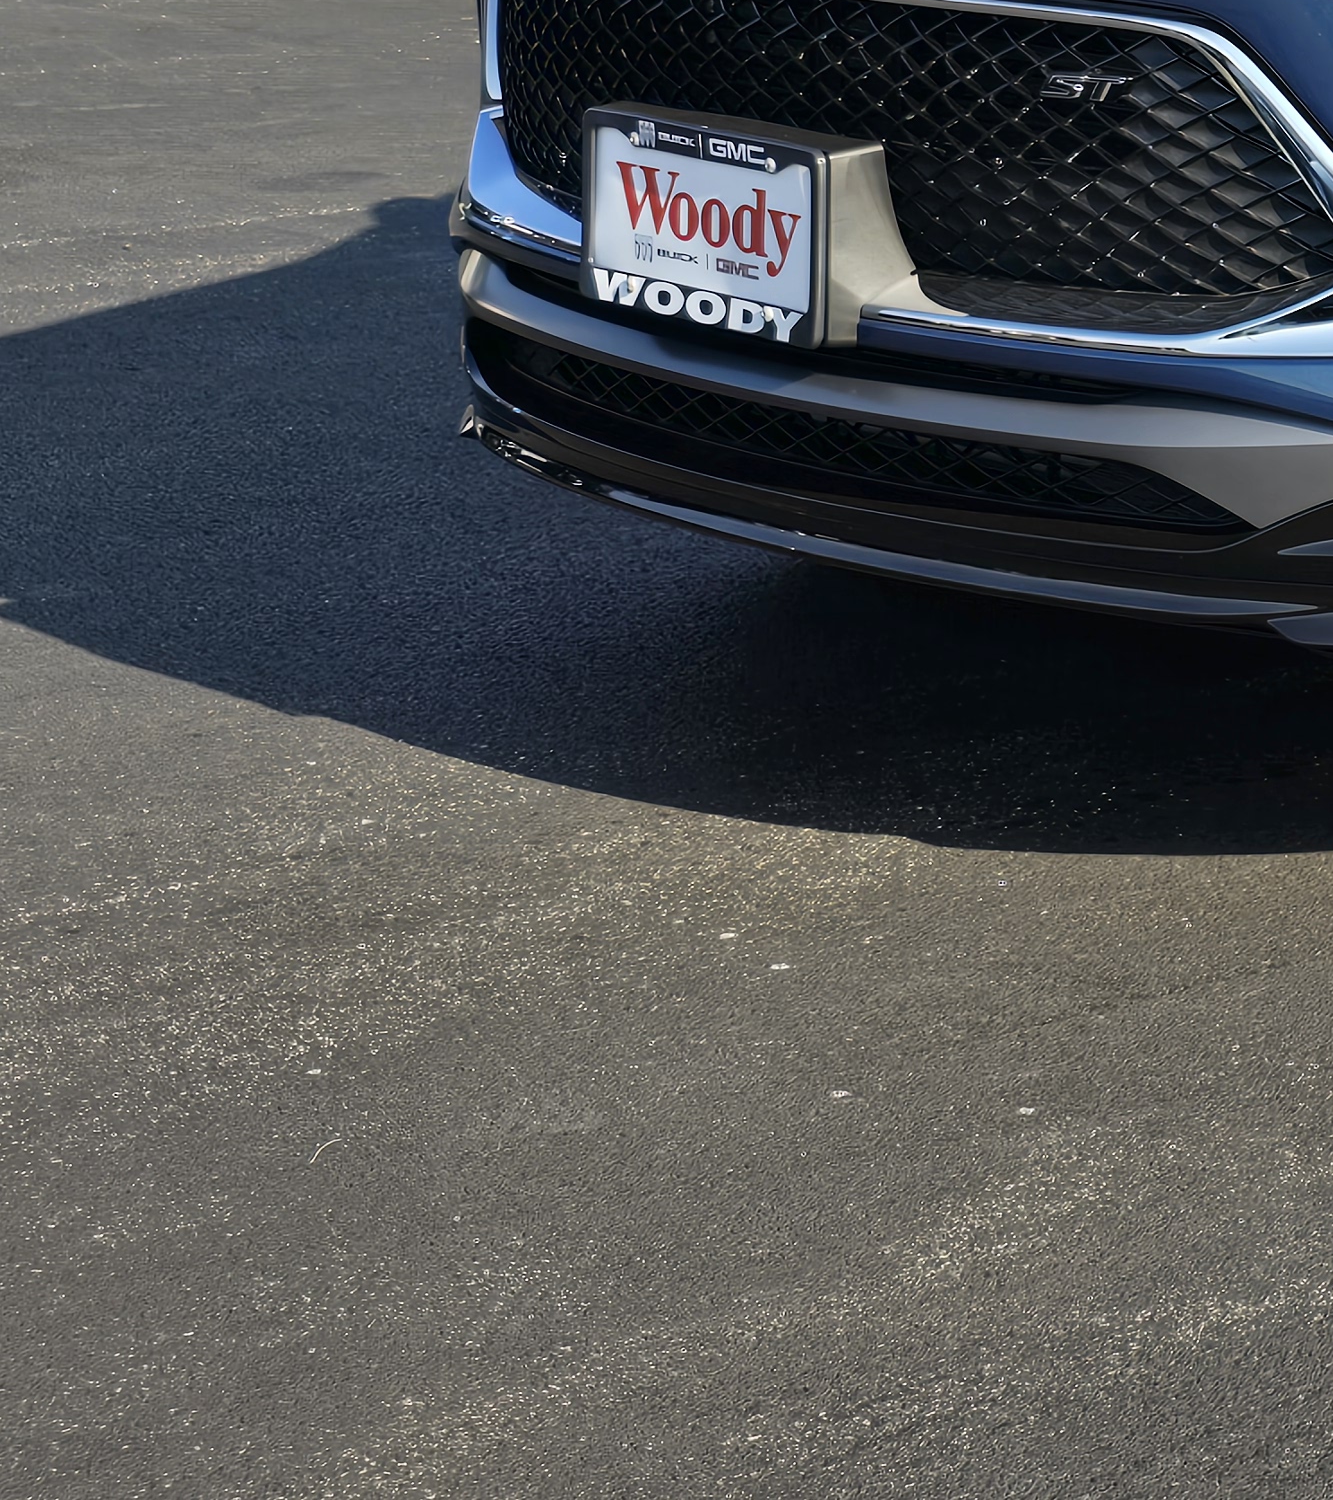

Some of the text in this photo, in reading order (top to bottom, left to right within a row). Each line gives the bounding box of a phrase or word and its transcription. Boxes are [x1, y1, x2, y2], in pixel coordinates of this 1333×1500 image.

[1040, 74, 1125, 102] ST
[657, 130, 767, 165] BUICK GMC
[616, 160, 802, 278] Woody
[656, 247, 760, 280] BUICK GMC
[593, 267, 804, 344] WOODY
